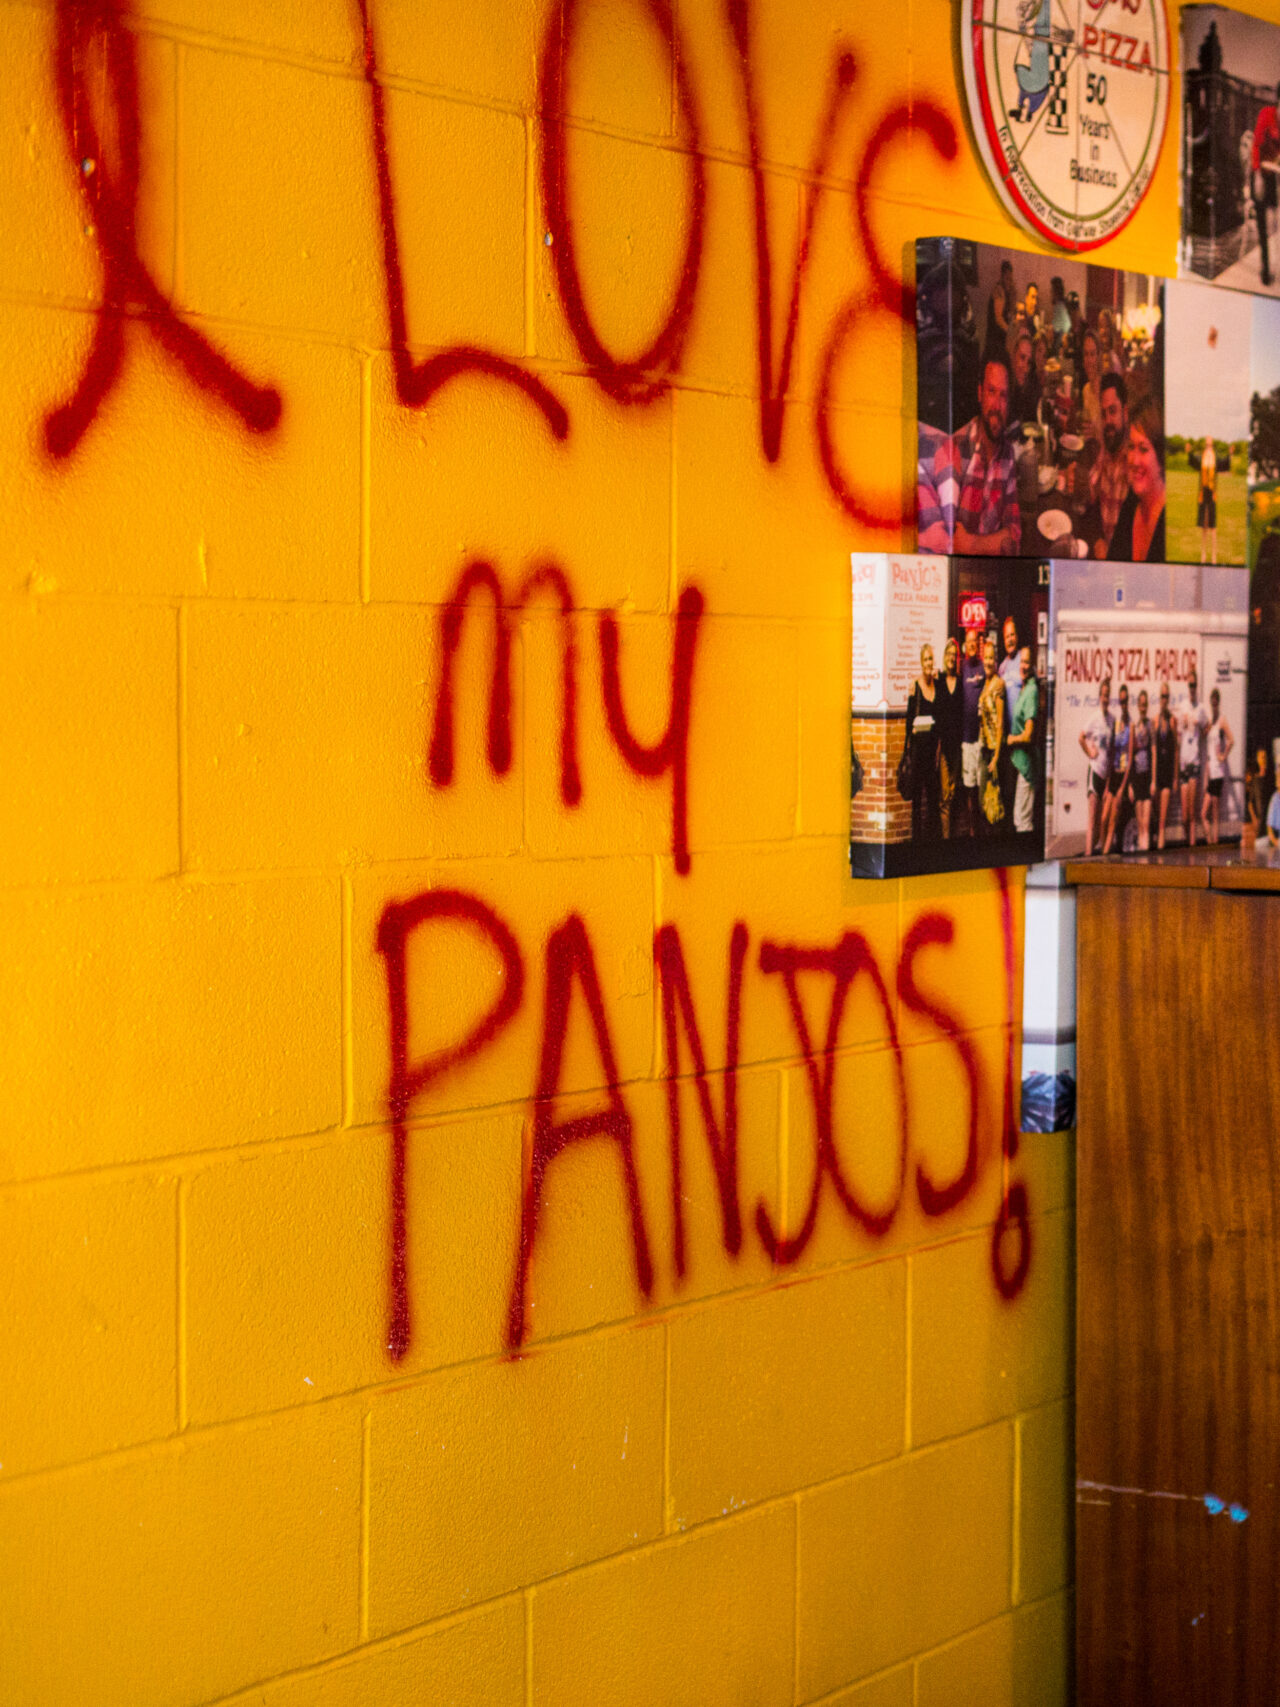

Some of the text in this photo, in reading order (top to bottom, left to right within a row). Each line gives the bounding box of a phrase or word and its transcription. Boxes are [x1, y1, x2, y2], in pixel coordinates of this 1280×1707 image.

[1083, 22, 1154, 76] PIZZA
[1086, 72, 1108, 106] 50
[1080, 113, 1111, 140] Years
[1089, 138, 1100, 161] in
[1070, 158, 1118, 188] Business
[961, 603, 987, 622] OPEN
[1064, 647, 1114, 683] PANJO'S
[1117, 647, 1150, 682] PIZZA
[1154, 647, 1198, 682] PARLOR
